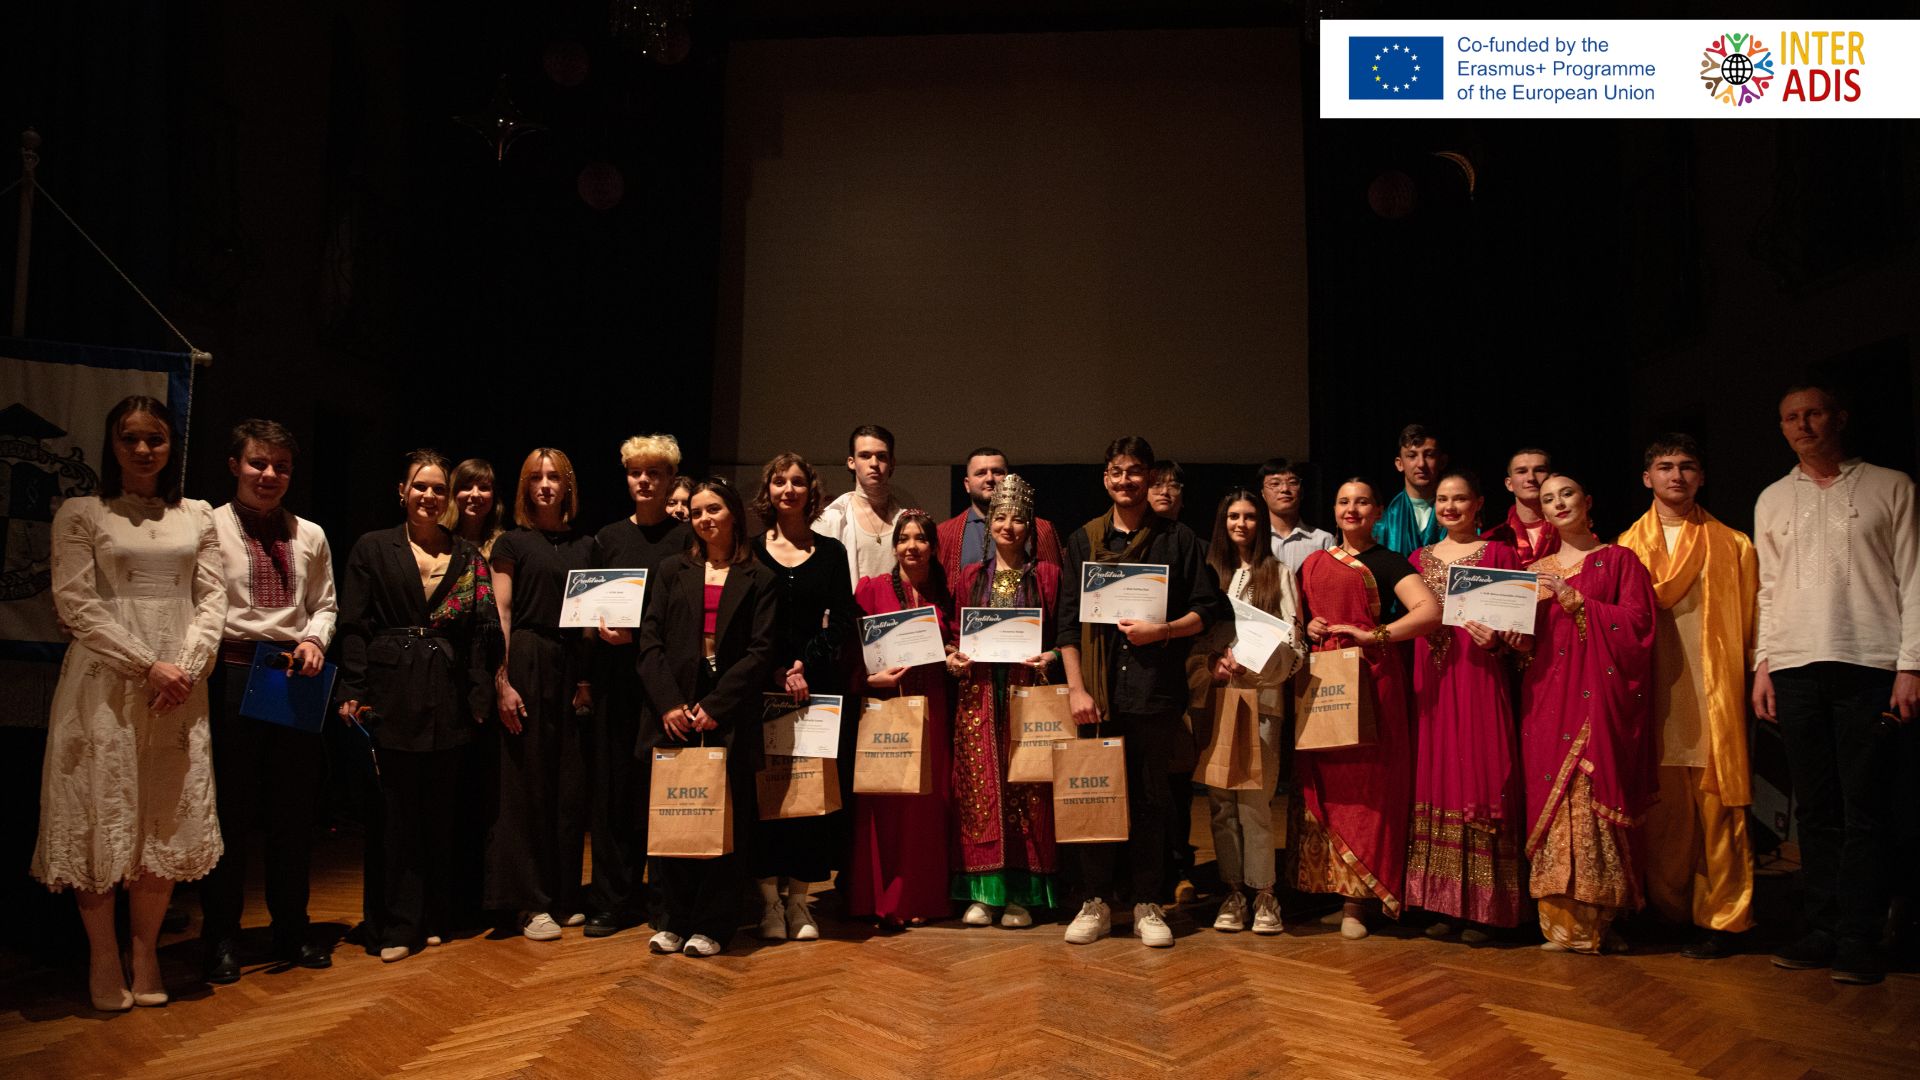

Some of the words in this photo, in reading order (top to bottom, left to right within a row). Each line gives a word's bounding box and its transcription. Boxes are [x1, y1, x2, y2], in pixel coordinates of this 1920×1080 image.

[1086, 566, 1125, 588] Gratitude
[1451, 569, 1493, 591] Gratitude
[569, 573, 606, 594] Gratitude
[964, 611, 1002, 631] Gratitude
[864, 618, 899, 641] Gratitude
[1311, 684, 1346, 698] KROK
[1304, 703, 1352, 714] UNIVERSITY
[1023, 721, 1063, 733] KROK
[873, 732, 910, 744] KROK
[864, 751, 912, 759] UNIVERSITY
[1069, 776, 1110, 789] KROK
[667, 787, 708, 799] KROK
[1063, 796, 1117, 805] UNIVERSITY
[659, 808, 716, 816] UNIVERSITY
